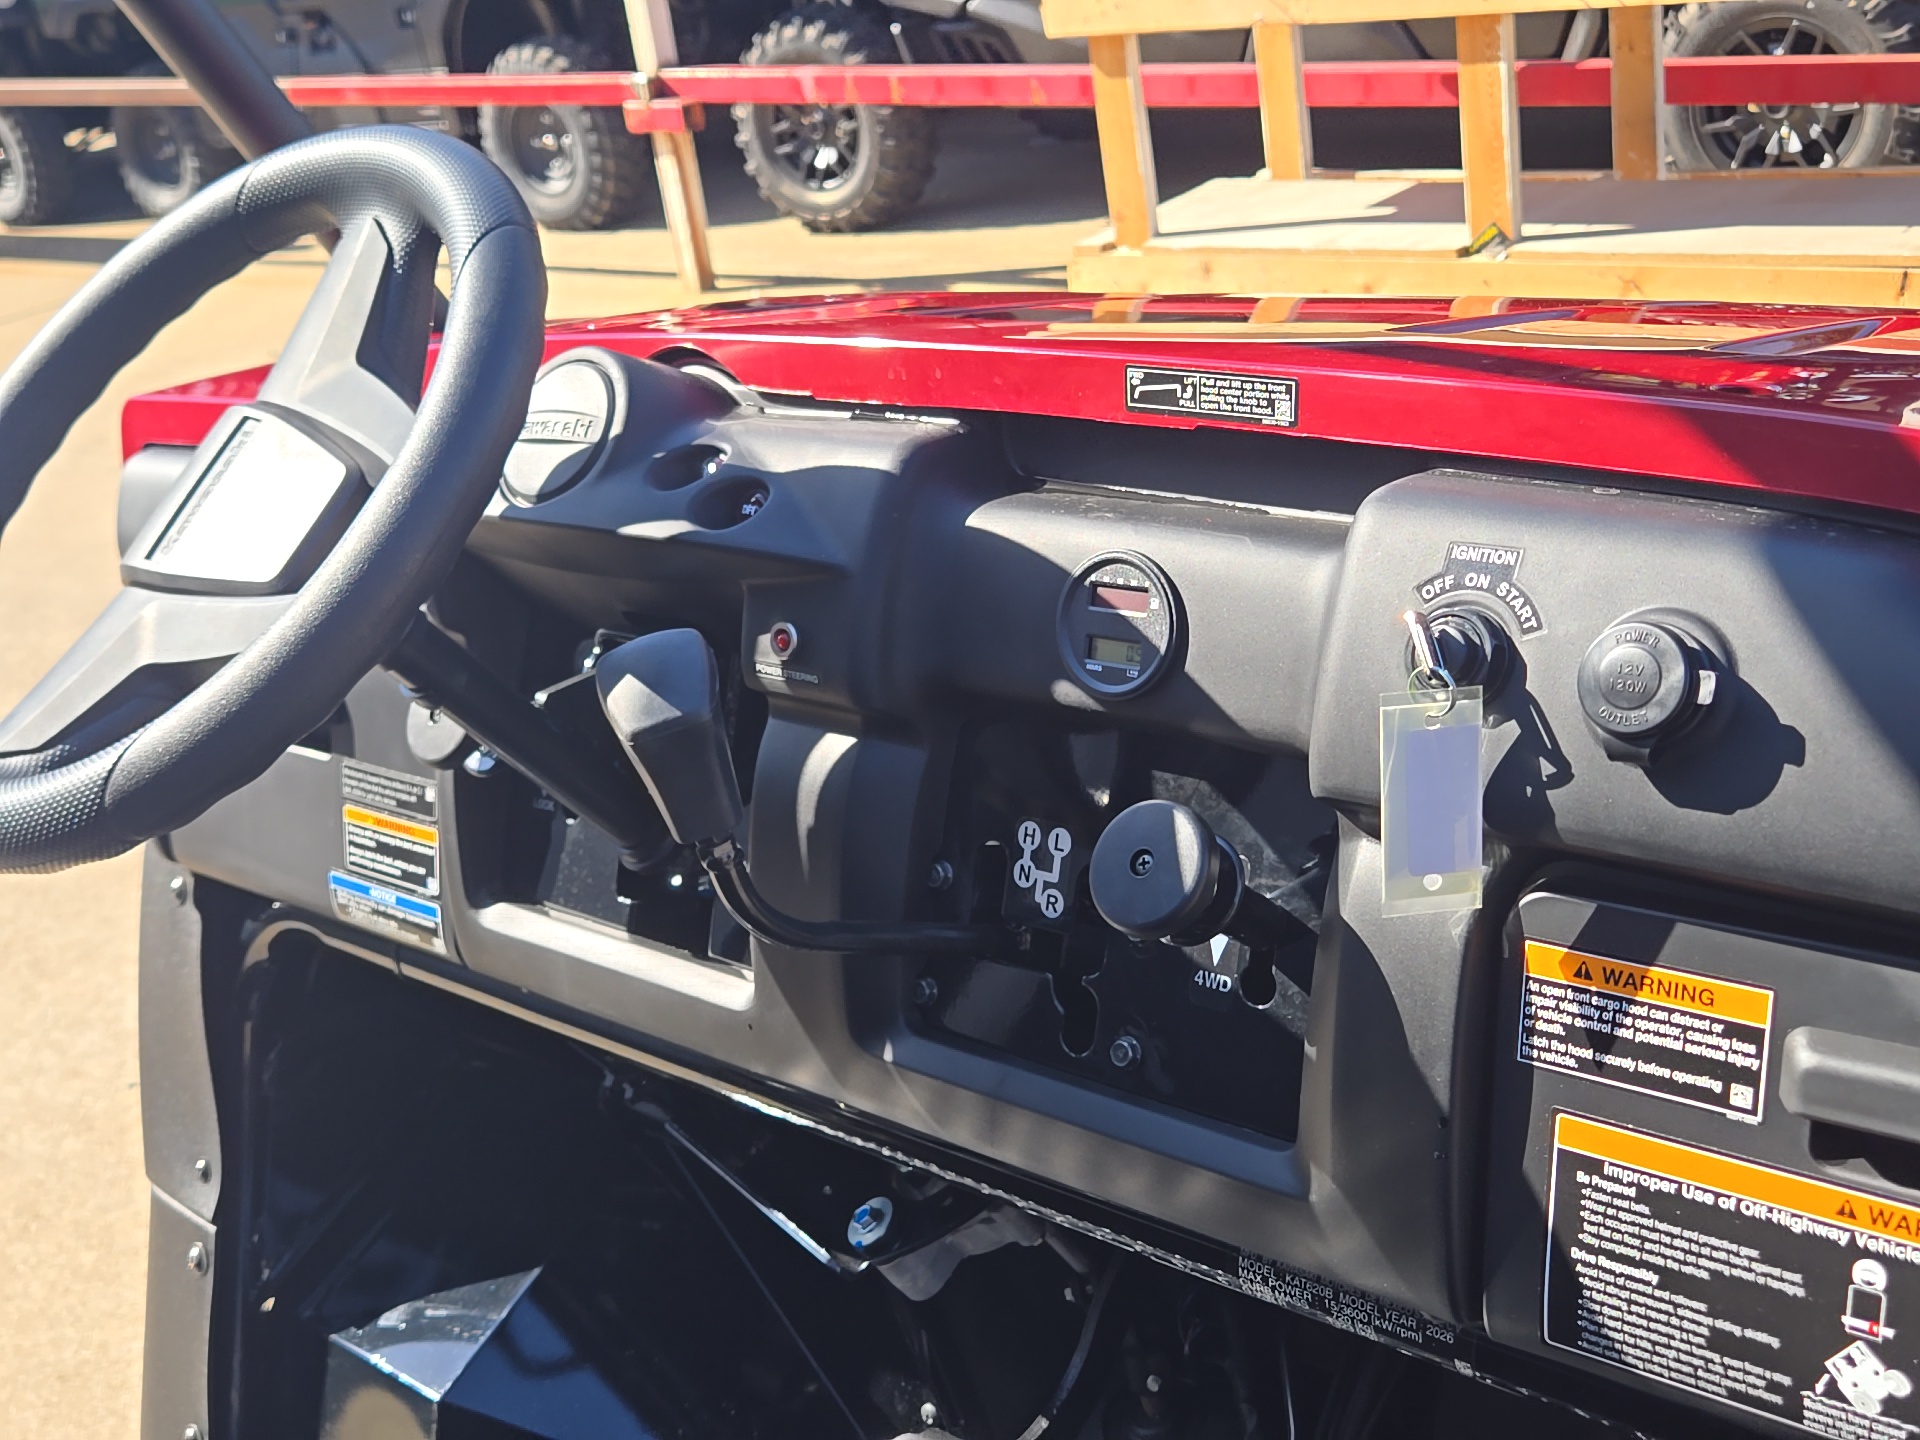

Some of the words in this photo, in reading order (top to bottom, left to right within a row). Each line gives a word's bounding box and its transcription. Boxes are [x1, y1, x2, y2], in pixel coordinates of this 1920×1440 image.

[1200, 377, 1214, 386] Pull
[1215, 379, 1229, 387] and
[1231, 380, 1241, 388] lift
[1242, 382, 1252, 390] up
[1253, 382, 1266, 390] the
[1267, 383, 1285, 392] front
[1200, 385, 1218, 395] hood
[1219, 388, 1242, 396] center
[1243, 388, 1269, 398] portion
[1270, 391, 1290, 400] while
[1200, 394, 1224, 403] pulling
[1225, 395, 1237, 404] the
[1239, 396, 1257, 405] knob
[1259, 398, 1267, 406] to
[1220, 402, 1231, 410] the
[1233, 403, 1250, 412] front
[1252, 405, 1273, 414] hood.
[1451, 544, 1518, 566] IGNITION
[1421, 574, 1455, 600] OFF
[1464, 573, 1491, 590] ON
[1496, 581, 1538, 631] START
[1614, 628, 1661, 649] POWER
[1617, 662, 1645, 677] 12V
[1609, 678, 1648, 694] 120W
[1598, 706, 1649, 726] OUTLET
[1023, 825, 1036, 846] H
[1054, 832, 1065, 853] L
[1018, 864, 1032, 883] N
[1045, 893, 1059, 914] R
[1194, 969, 1232, 994] 4WD
[1601, 965, 1715, 1008] WARNING
[1527, 979, 1539, 992] An
[1541, 984, 1565, 997] open
[1566, 987, 1589, 1003] front
[1591, 995, 1620, 1010] cargo
[1622, 1001, 1648, 1016] hood
[1649, 1008, 1668, 1021] can
[1670, 1012, 1710, 1030] distract
[1711, 1022, 1724, 1033] or
[1524, 1018, 1535, 1027] or
[1535, 1019, 1565, 1035] death.
[1525, 992, 1557, 1008] impair
[1559, 999, 1600, 1018] visibility
[1602, 1008, 1613, 1021] of
[1615, 1012, 1633, 1026] the
[1634, 1018, 1684, 1038] operator,
[1686, 1030, 1730, 1049] causing
[1731, 1037, 1756, 1054] loss
[1525, 1005, 1535, 1015] of
[1537, 1008, 1572, 1024] vehicle
[1573, 1016, 1611, 1033] control
[1613, 1026, 1634, 1039] and
[1635, 1030, 1683, 1050] potential
[1684, 1042, 1725, 1061] serious
[1727, 1050, 1760, 1069] injury
[1522, 1045, 1539, 1058] the
[1540, 1050, 1579, 1068] vehicle.
[1522, 1032, 1549, 1049] Latch
[1550, 1039, 1566, 1054] the
[1567, 1042, 1593, 1059] hood
[1595, 1052, 1636, 1070] securely
[1637, 1059, 1671, 1078] before
[1671, 1070, 1723, 1090] operating
[1576, 1170, 1590, 1184] Be
[1591, 1175, 1636, 1197] Prepared
[1603, 1161, 1679, 1195] Improper
[1681, 1183, 1715, 1205] Use
[1717, 1196, 1737, 1212] of
[1739, 1200, 1852, 1248] Off-Highway
[1570, 1246, 1596, 1264] Drive
[1597, 1255, 1659, 1284] Responsibly
[1238, 1255, 1277, 1279] MODEL
[1285, 1272, 1334, 1299] KAT620B
[1339, 1292, 1381, 1317] MODEL
[1384, 1307, 1417, 1330] YEAR
[1425, 1324, 1455, 1344] 2026
[1238, 1266, 1266, 1286] MAX.
[1268, 1277, 1312, 1303] POWER
[1324, 1299, 1368, 1323] 15/3600
[1371, 1314, 1423, 1344] (kW/rpm)
